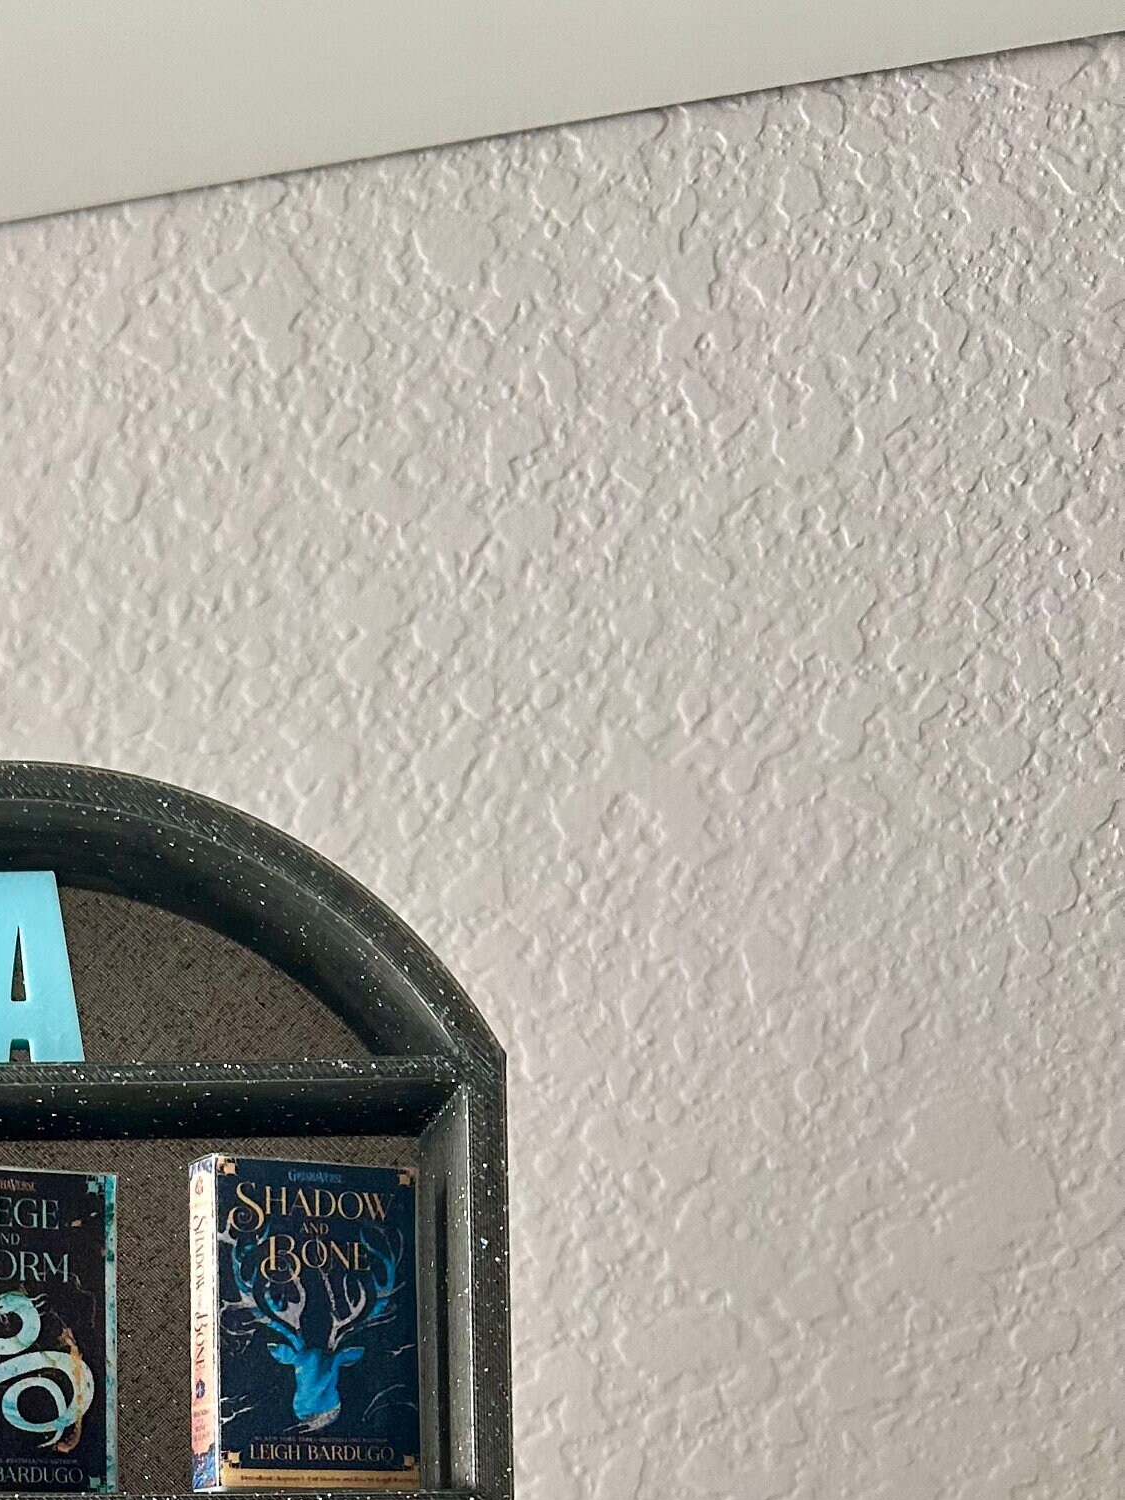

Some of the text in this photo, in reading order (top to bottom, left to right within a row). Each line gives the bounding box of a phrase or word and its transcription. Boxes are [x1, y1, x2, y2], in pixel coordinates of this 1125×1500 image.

[227, 1182, 396, 1233] SHADOW
[300, 1222, 329, 1235] AND
[260, 1234, 371, 1284] BONE
[250, 1443, 394, 1462] LEIGH BARDUGO
